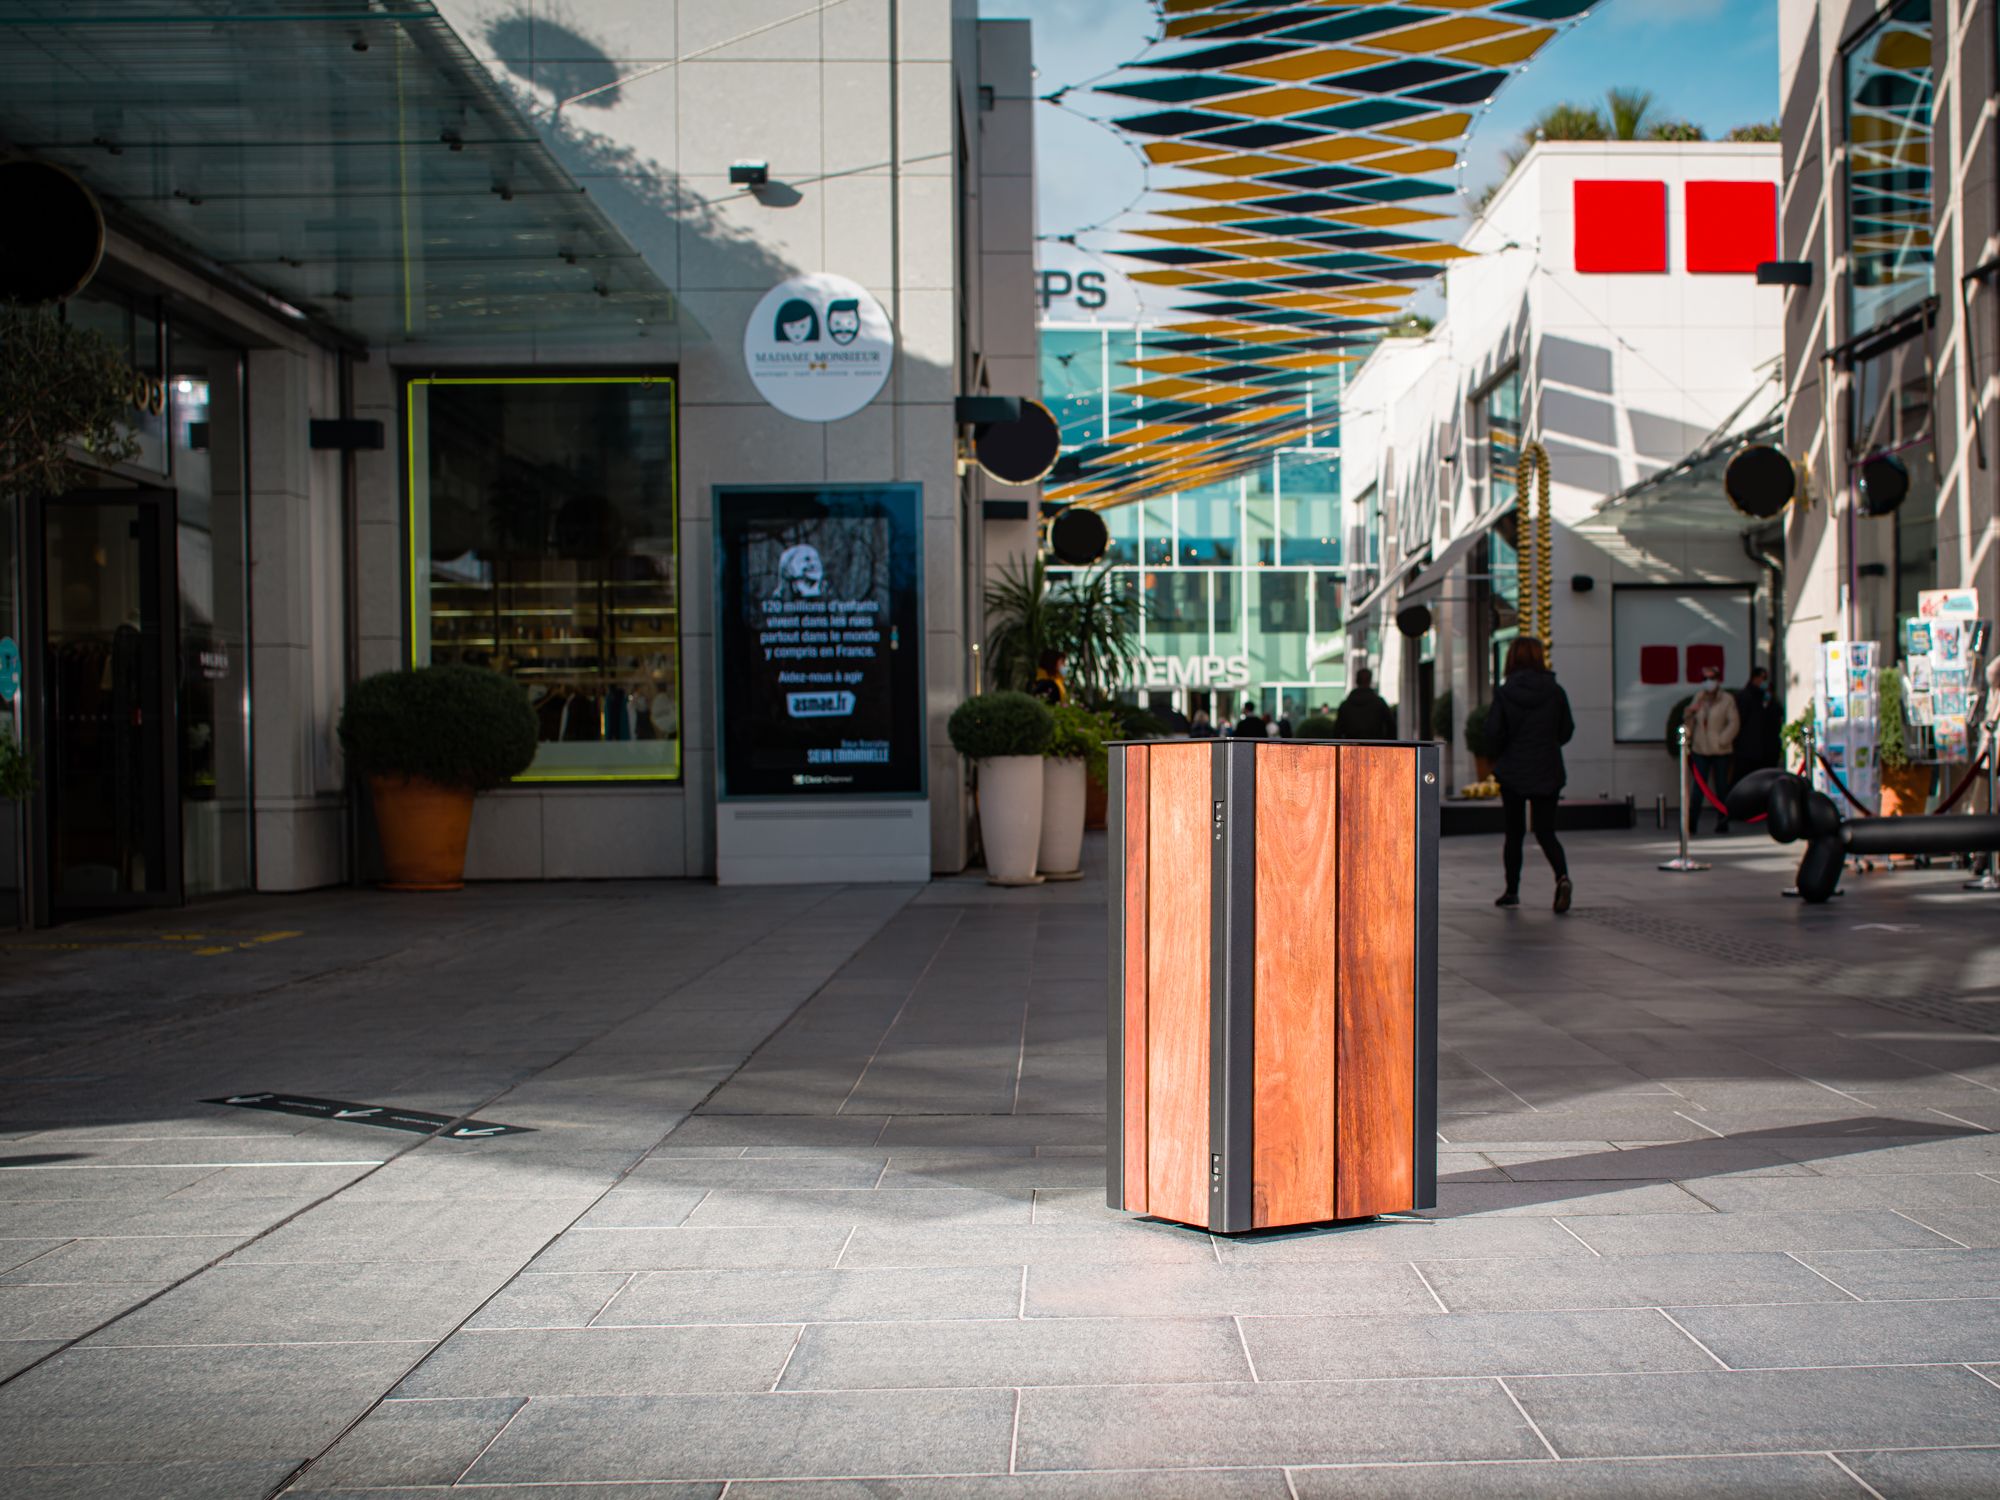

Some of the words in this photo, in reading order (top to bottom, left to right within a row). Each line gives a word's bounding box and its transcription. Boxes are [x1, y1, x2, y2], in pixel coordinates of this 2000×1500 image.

[755, 351, 810, 362] MADAME
[814, 350, 881, 362] MONSIEUR
[761, 600, 782, 614] 120
[783, 600, 827, 613] millions
[801, 615, 828, 628] dans
[829, 615, 847, 628] les
[759, 630, 800, 646] partout
[801, 630, 829, 643] dans
[829, 630, 841, 643] le
[842, 630, 881, 643] monde
[773, 646, 818, 661] compris
[819, 647, 834, 658] en
